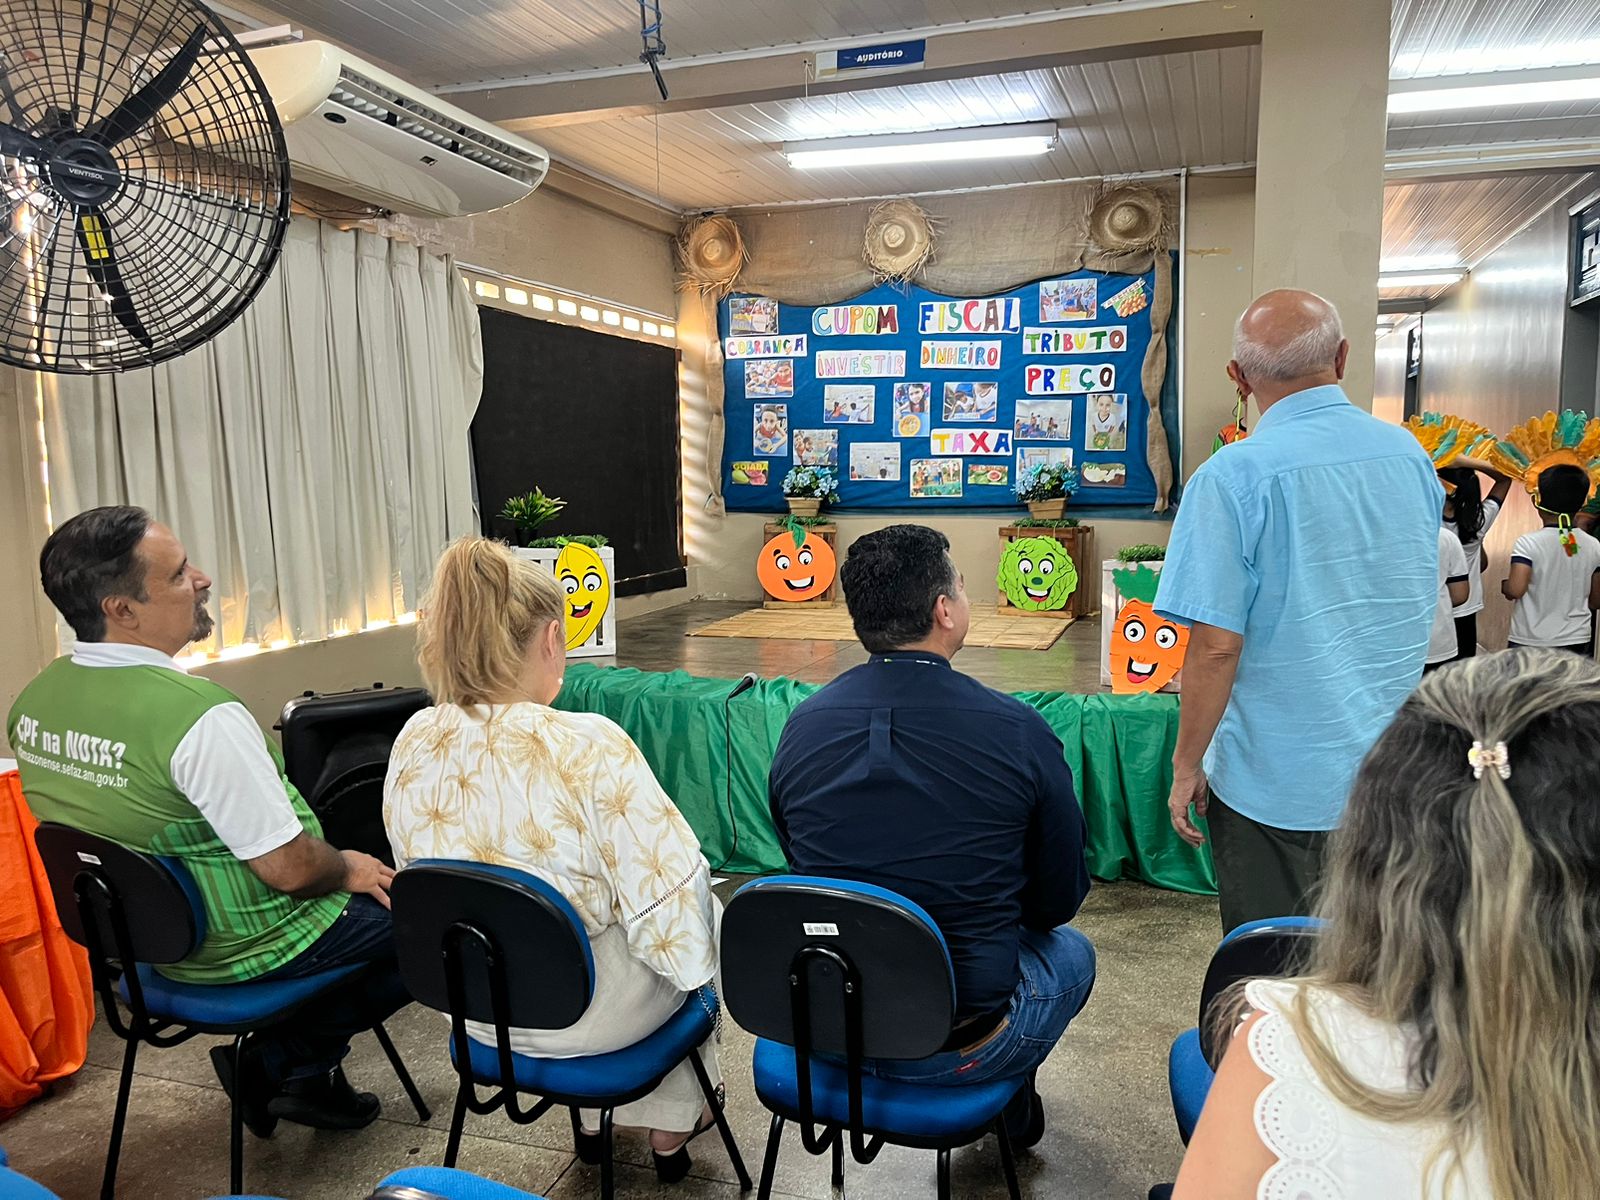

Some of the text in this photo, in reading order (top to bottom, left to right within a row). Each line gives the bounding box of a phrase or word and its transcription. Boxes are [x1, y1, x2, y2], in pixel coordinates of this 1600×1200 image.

[856, 50, 903, 63] AUDITÓRIO
[68, 167, 104, 181] VENTISOL
[813, 298, 1019, 335] CUPOM FISCAL
[727, 337, 804, 357] COBRANÇA
[1025, 329, 1125, 353] TRIBUTO
[817, 352, 905, 377] INVESTIR
[922, 342, 998, 366] DINHEIRO
[1027, 366, 1113, 392] PREÇO
[932, 430, 1010, 453] TAXA
[16, 714, 126, 770] CPF na NOTA?
